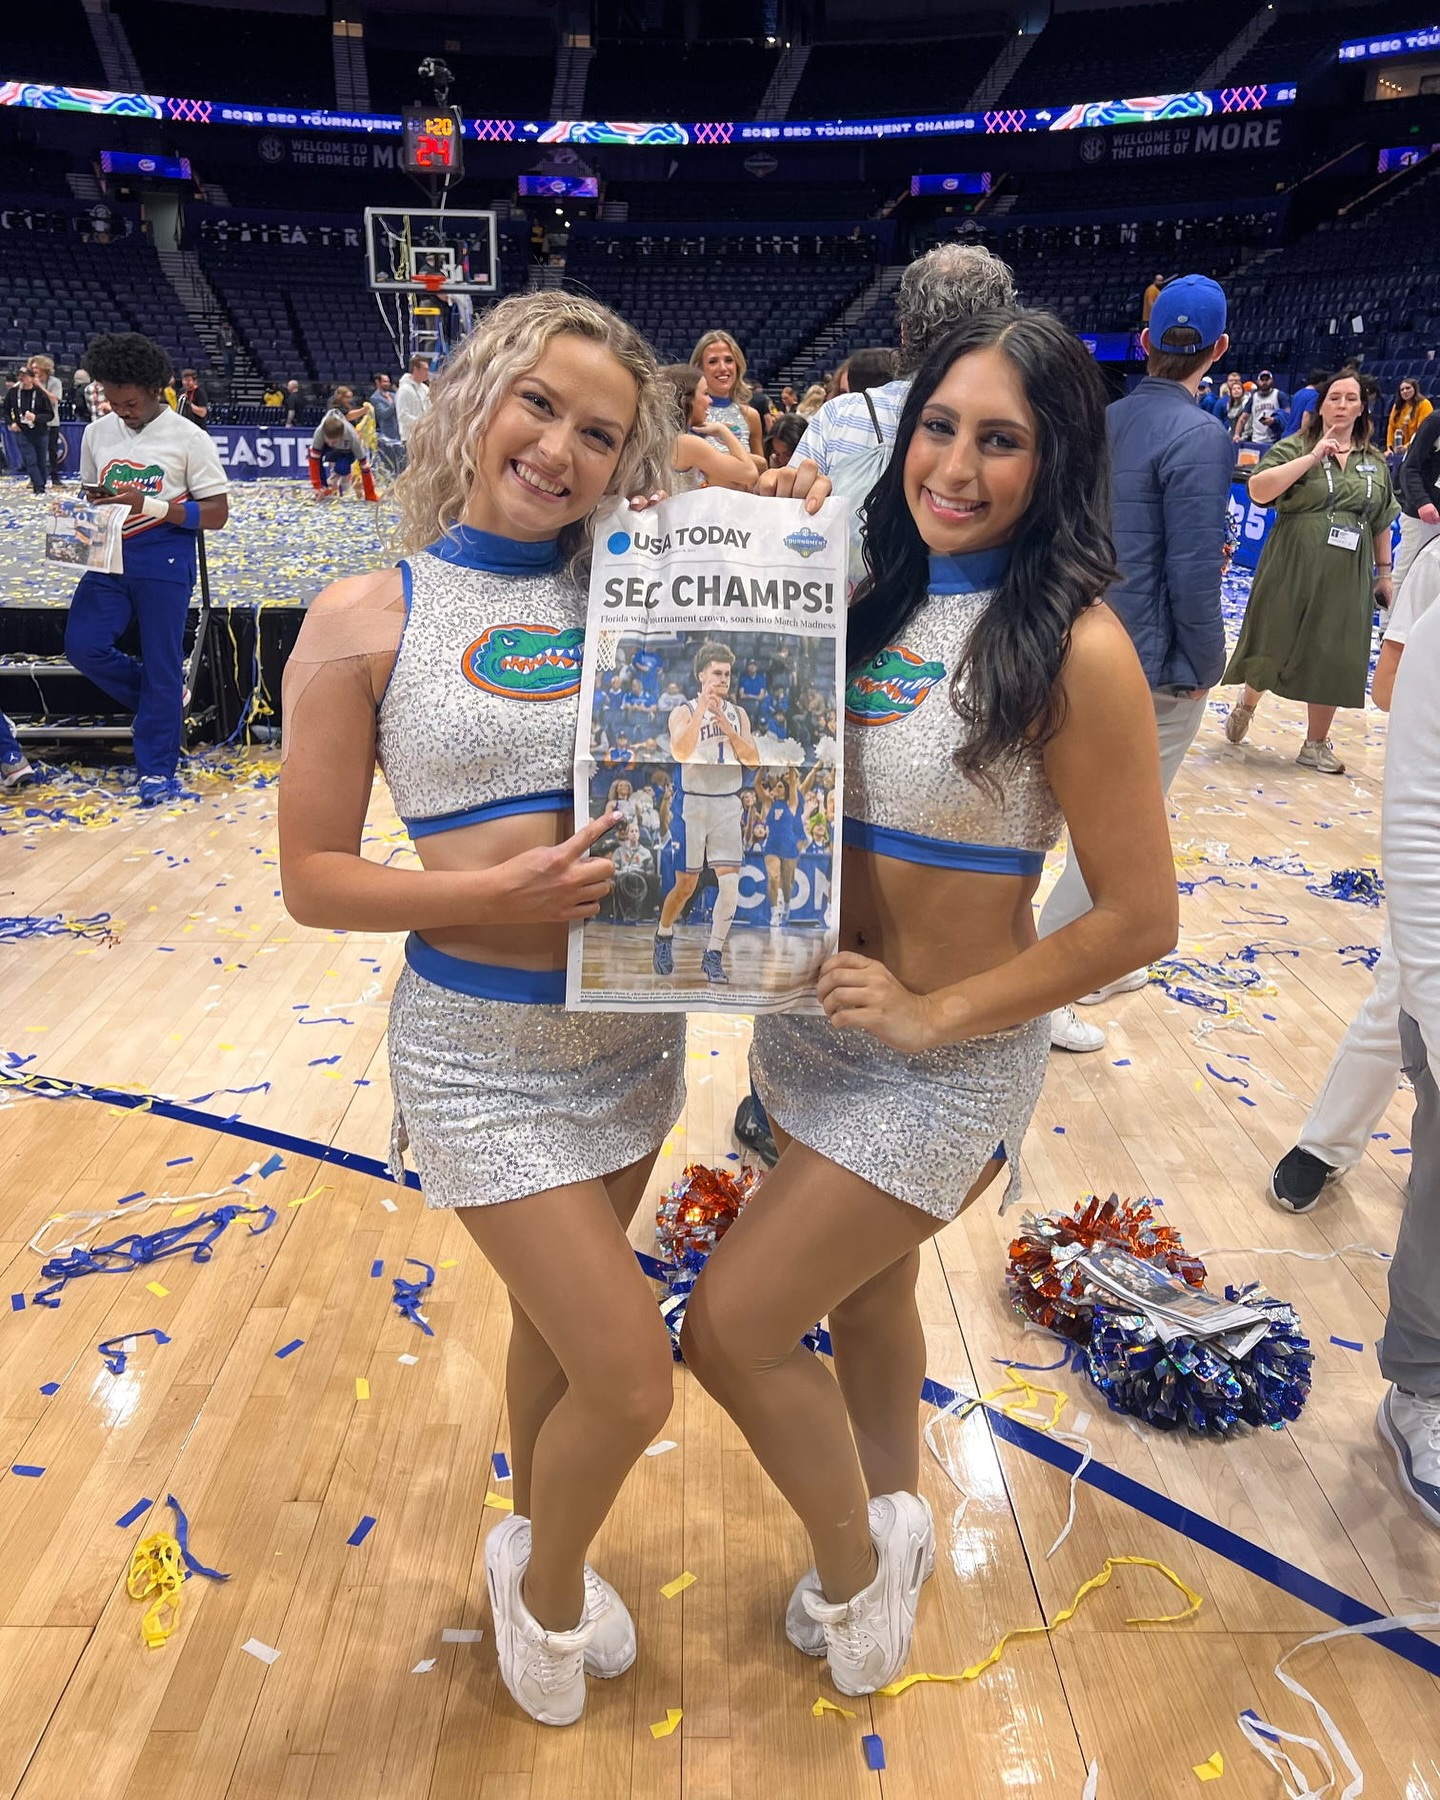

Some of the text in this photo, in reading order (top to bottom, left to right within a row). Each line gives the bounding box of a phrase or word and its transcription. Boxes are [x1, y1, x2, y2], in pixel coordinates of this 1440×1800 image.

[301, 114, 402, 131] TOURNAMENT
[815, 122, 911, 137] TOURNAMENT
[914, 119, 975, 133] CHAMPS
[1112, 127, 1191, 146] WELCOME TO
[1194, 118, 1284, 153] MORE
[291, 139, 368, 155] WELCOME TO
[416, 135, 450, 167] 24
[1111, 141, 1190, 160] THE HOME OF
[291, 151, 368, 167] THE HOME OF
[634, 532, 672, 555] USA
[675, 525, 752, 550] TODAY
[603, 575, 834, 614] SEC CHAMPS!
[600, 614, 629, 624] Florida
[699, 615, 728, 625] crown,
[730, 616, 754, 624] soars
[755, 614, 773, 624] into
[774, 616, 799, 628] March
[800, 620, 837, 630] Madness
[717, 741, 725, 764] 1
